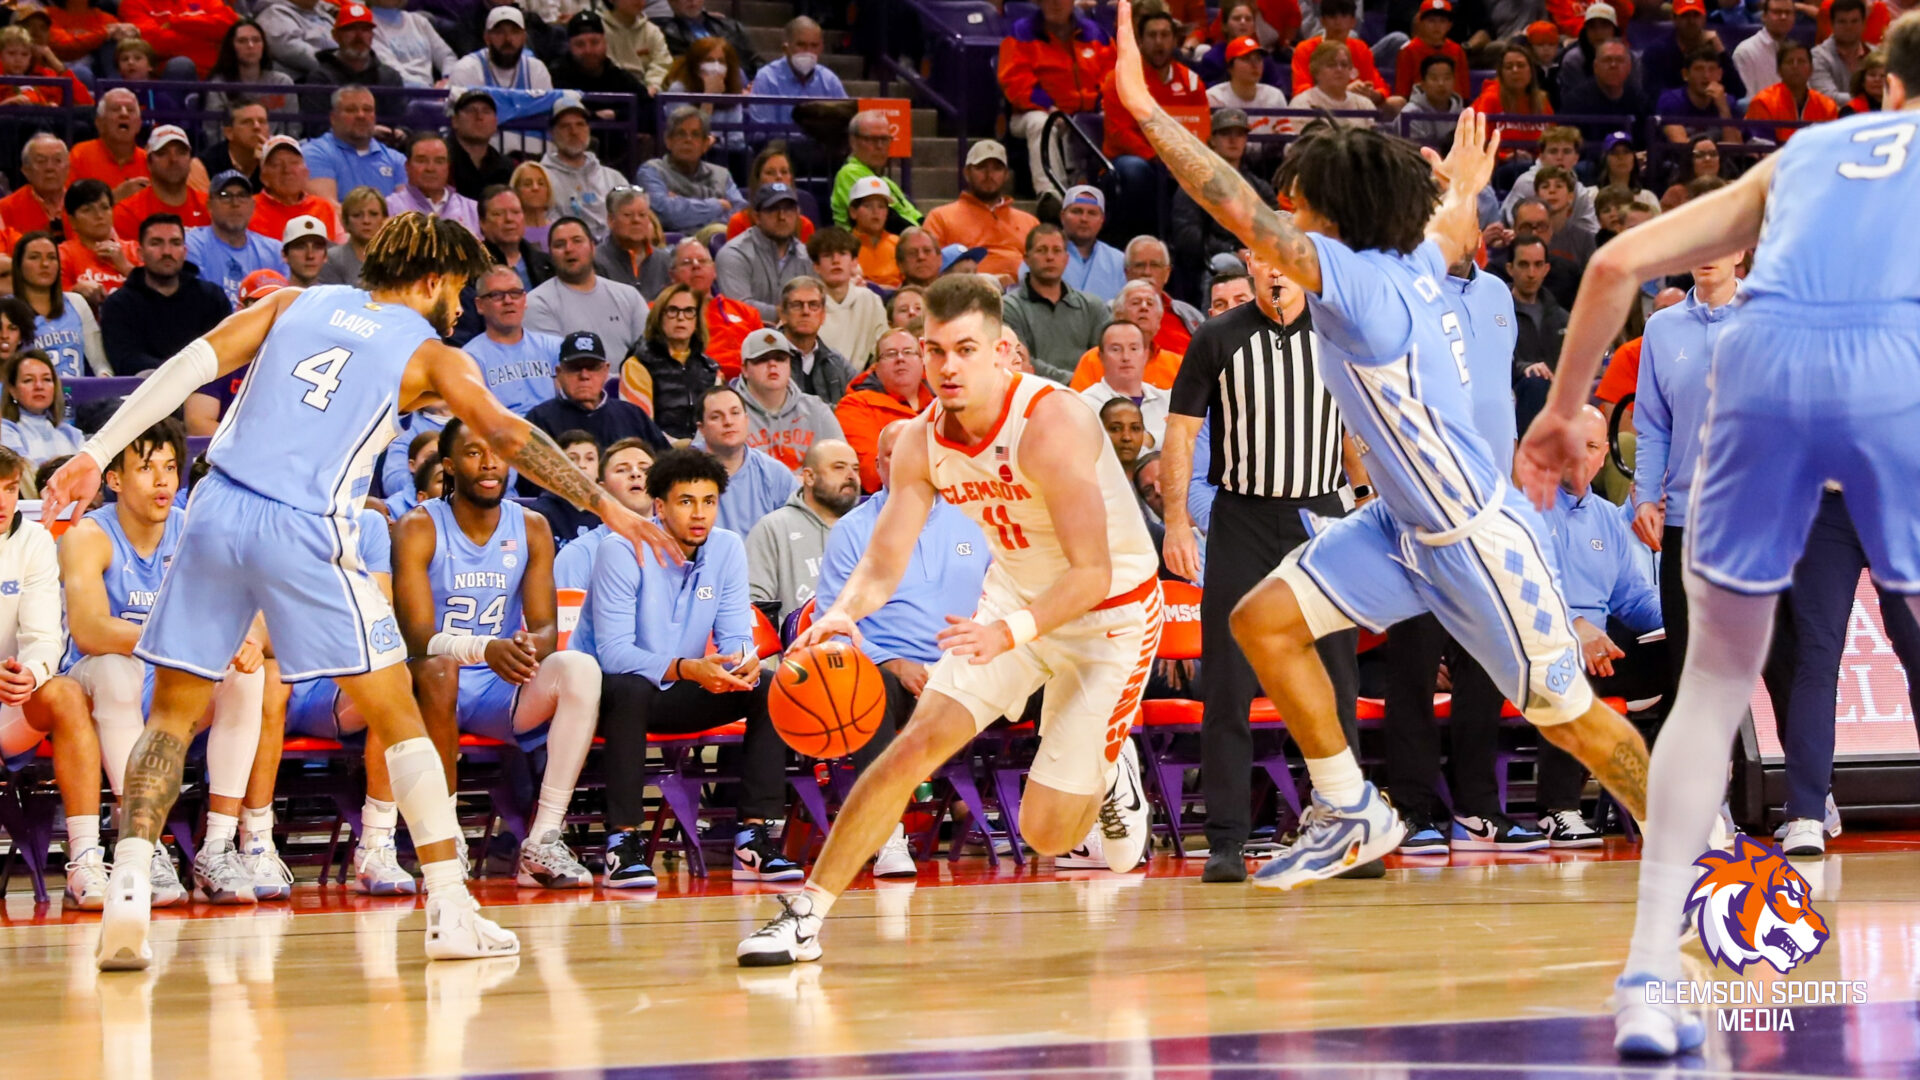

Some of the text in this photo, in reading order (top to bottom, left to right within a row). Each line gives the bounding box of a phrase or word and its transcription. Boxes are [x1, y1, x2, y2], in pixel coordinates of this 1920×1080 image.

[1836, 123, 1918, 180] 3
[329, 308, 383, 339] DAVIS
[33, 330, 80, 350] NORTH
[291, 345, 354, 413] 4
[487, 360, 556, 387] CAROLINA
[940, 480, 1033, 505] CLEMSON
[982, 504, 1030, 551] 11
[453, 571, 508, 590] NORTH
[440, 594, 508, 637] 24
